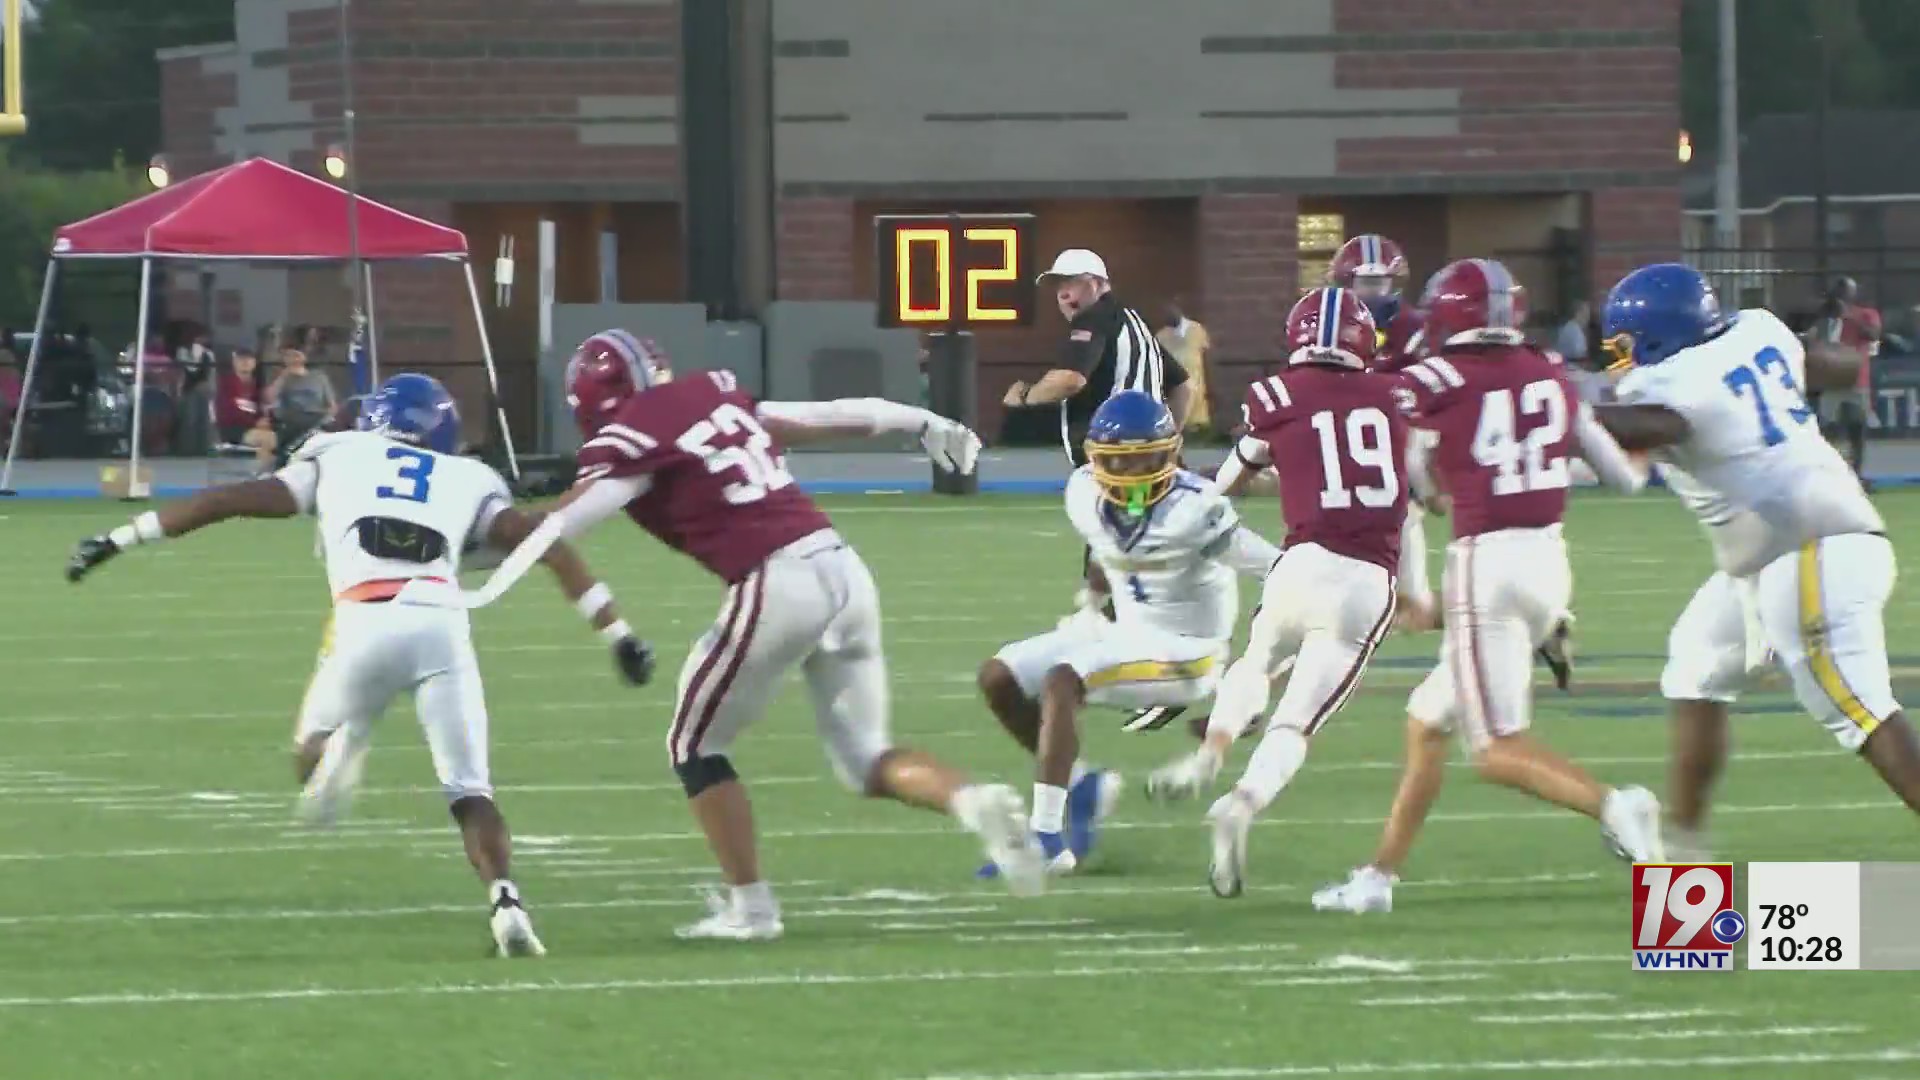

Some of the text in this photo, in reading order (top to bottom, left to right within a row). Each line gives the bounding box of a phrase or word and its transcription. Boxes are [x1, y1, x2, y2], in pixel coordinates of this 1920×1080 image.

[896, 228, 1017, 321] 02
[1471, 379, 1569, 496] 42
[1722, 346, 1812, 447] 73
[376, 447, 436, 503] 3
[676, 403, 795, 505] 52
[1311, 407, 1400, 509] 19
